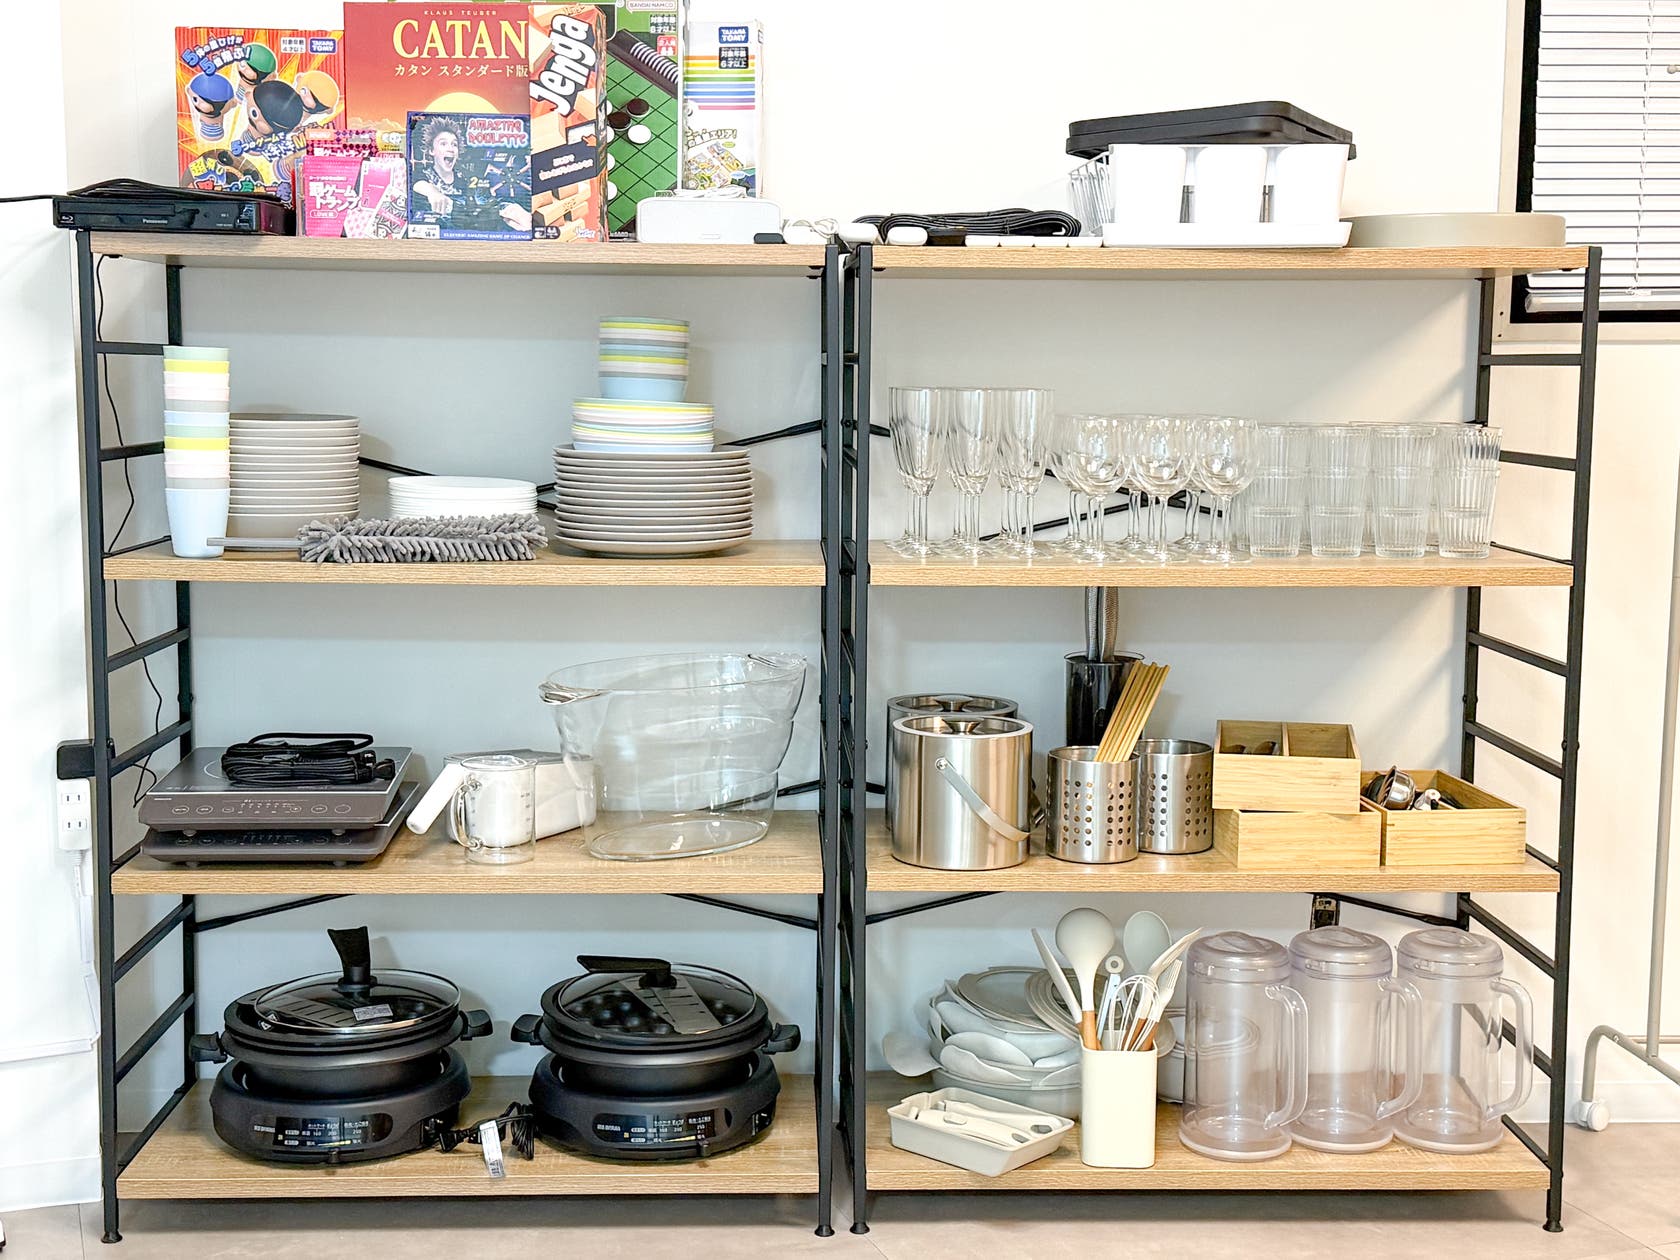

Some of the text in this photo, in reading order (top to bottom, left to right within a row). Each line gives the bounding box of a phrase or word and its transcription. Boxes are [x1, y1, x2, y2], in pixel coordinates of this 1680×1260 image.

[392, 19, 529, 59] CATAN
[394, 64, 529, 78] カタン スタンダード版
[529, 14, 597, 117] Jenga
[468, 132, 528, 145] ROULETTE
[314, 196, 361, 212] トランプ
